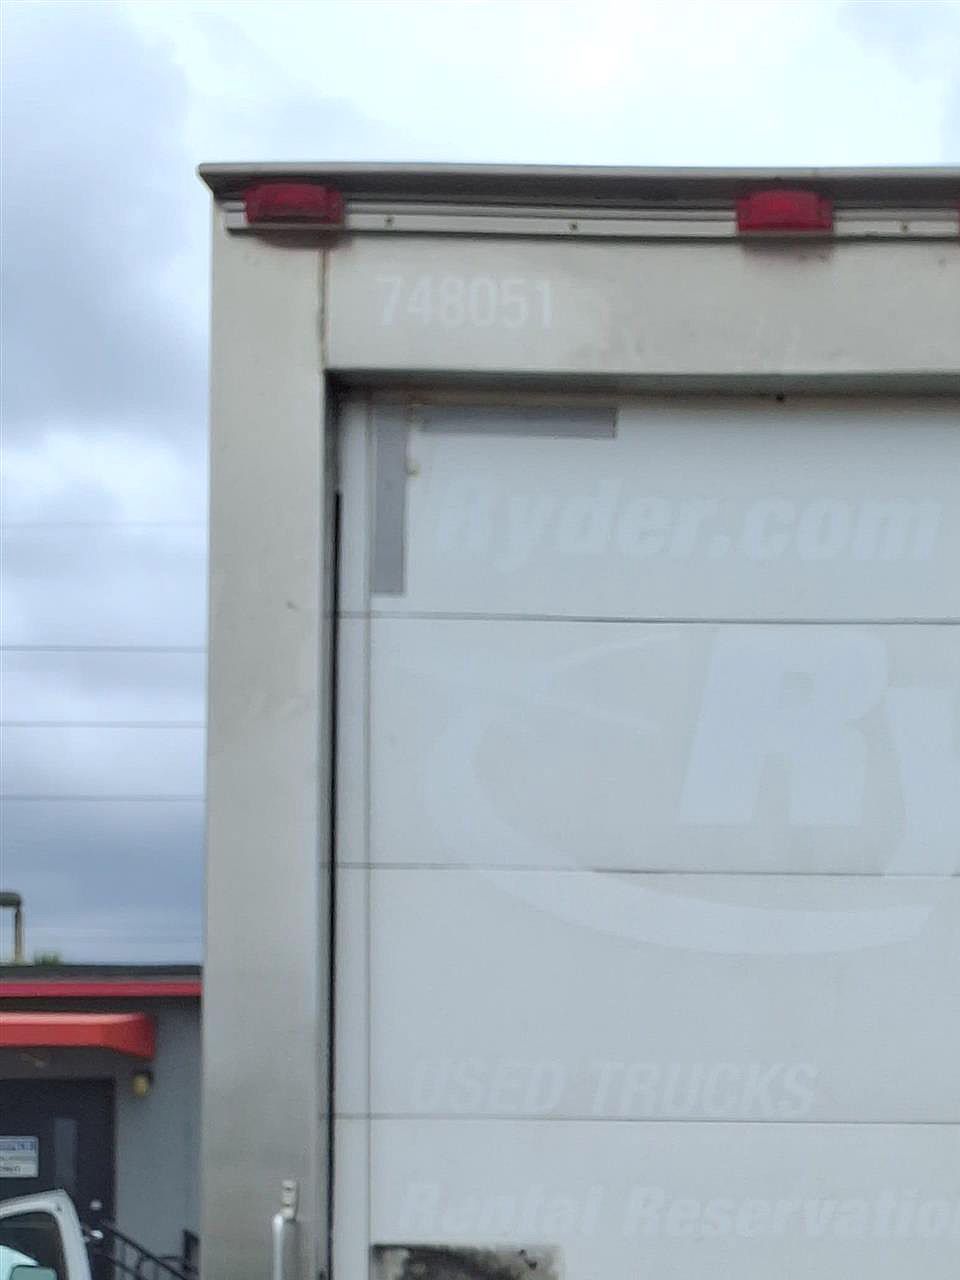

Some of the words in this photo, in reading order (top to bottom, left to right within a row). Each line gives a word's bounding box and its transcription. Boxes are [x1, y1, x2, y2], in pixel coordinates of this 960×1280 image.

[376, 272, 555, 329] 748051
[433, 475, 943, 573] Ryder.com
[408, 1057, 567, 1114] USED
[592, 1060, 819, 1118] TRUCKS
